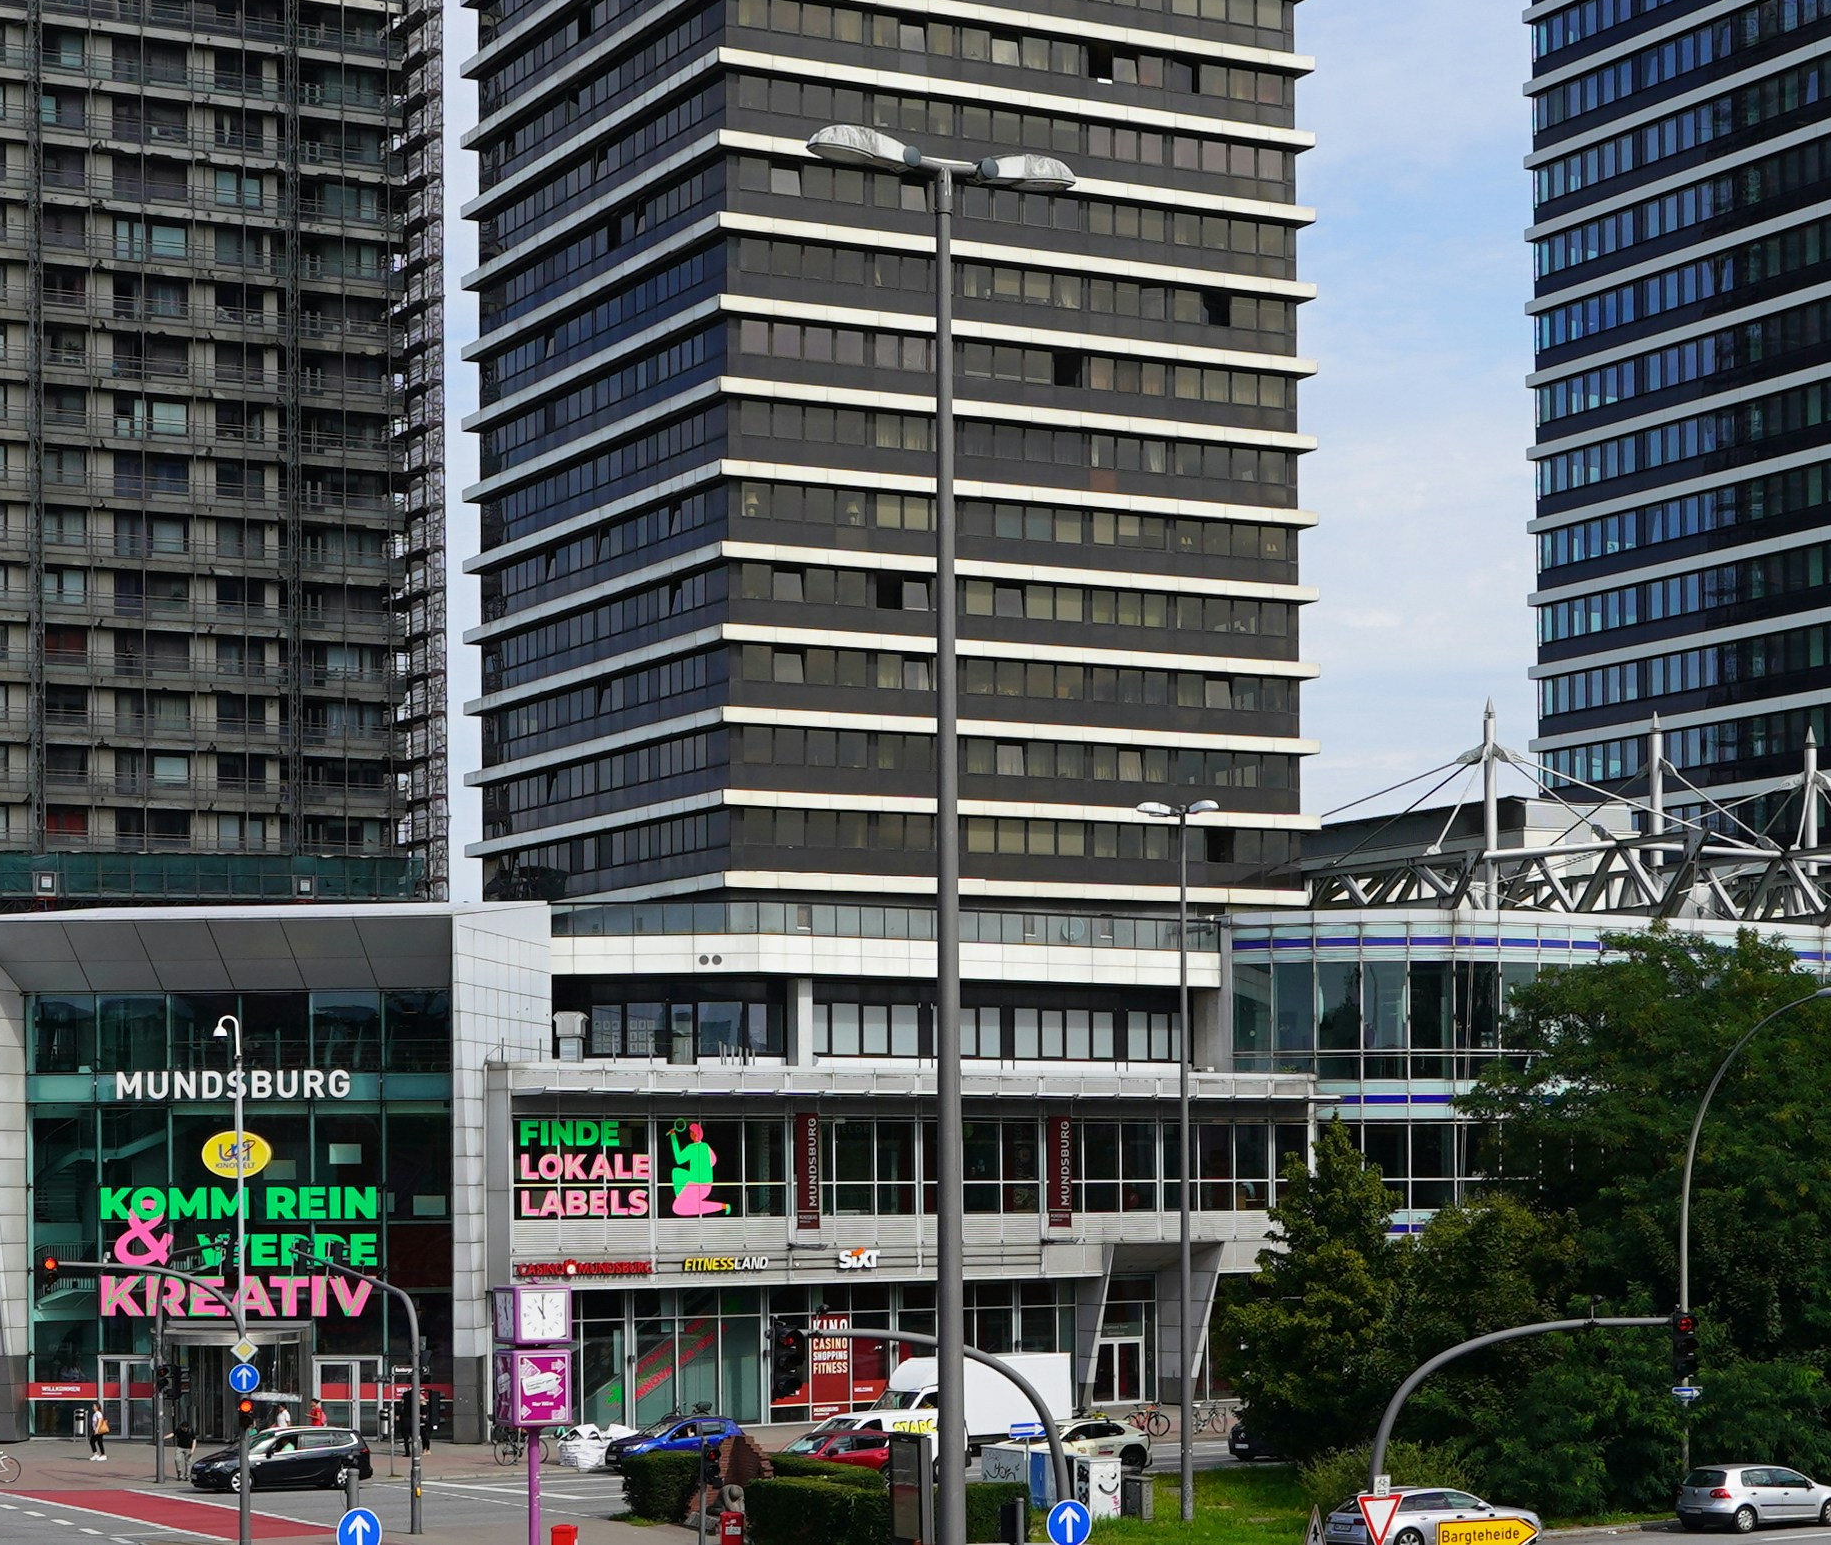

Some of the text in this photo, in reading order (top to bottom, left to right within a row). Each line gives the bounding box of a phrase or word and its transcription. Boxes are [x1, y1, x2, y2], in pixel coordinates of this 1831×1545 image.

[116, 1069, 351, 1100] MUNDSBURG
[520, 1120, 620, 1146] FINDE
[520, 1153, 651, 1180] LOKALE
[808, 1117, 818, 1207] MUNDSBURG
[1060, 1120, 1070, 1206] MUNDSBURG
[100, 1186, 377, 1220] KOMM REIN
[520, 1189, 649, 1217] LABELS
[114, 1199, 174, 1266] &
[517, 1261, 653, 1276] CASINO MUNDSBURG
[683, 1256, 769, 1273] FITNESSLAND
[100, 1275, 377, 1317] KREATIV
[813, 1319, 848, 1329] KINO
[813, 1338, 848, 1350] CASINO
[813, 1351, 848, 1361] SHOPPING
[813, 1362, 849, 1374] FITNESS
[1441, 1526, 1520, 1545] Bargteheide
